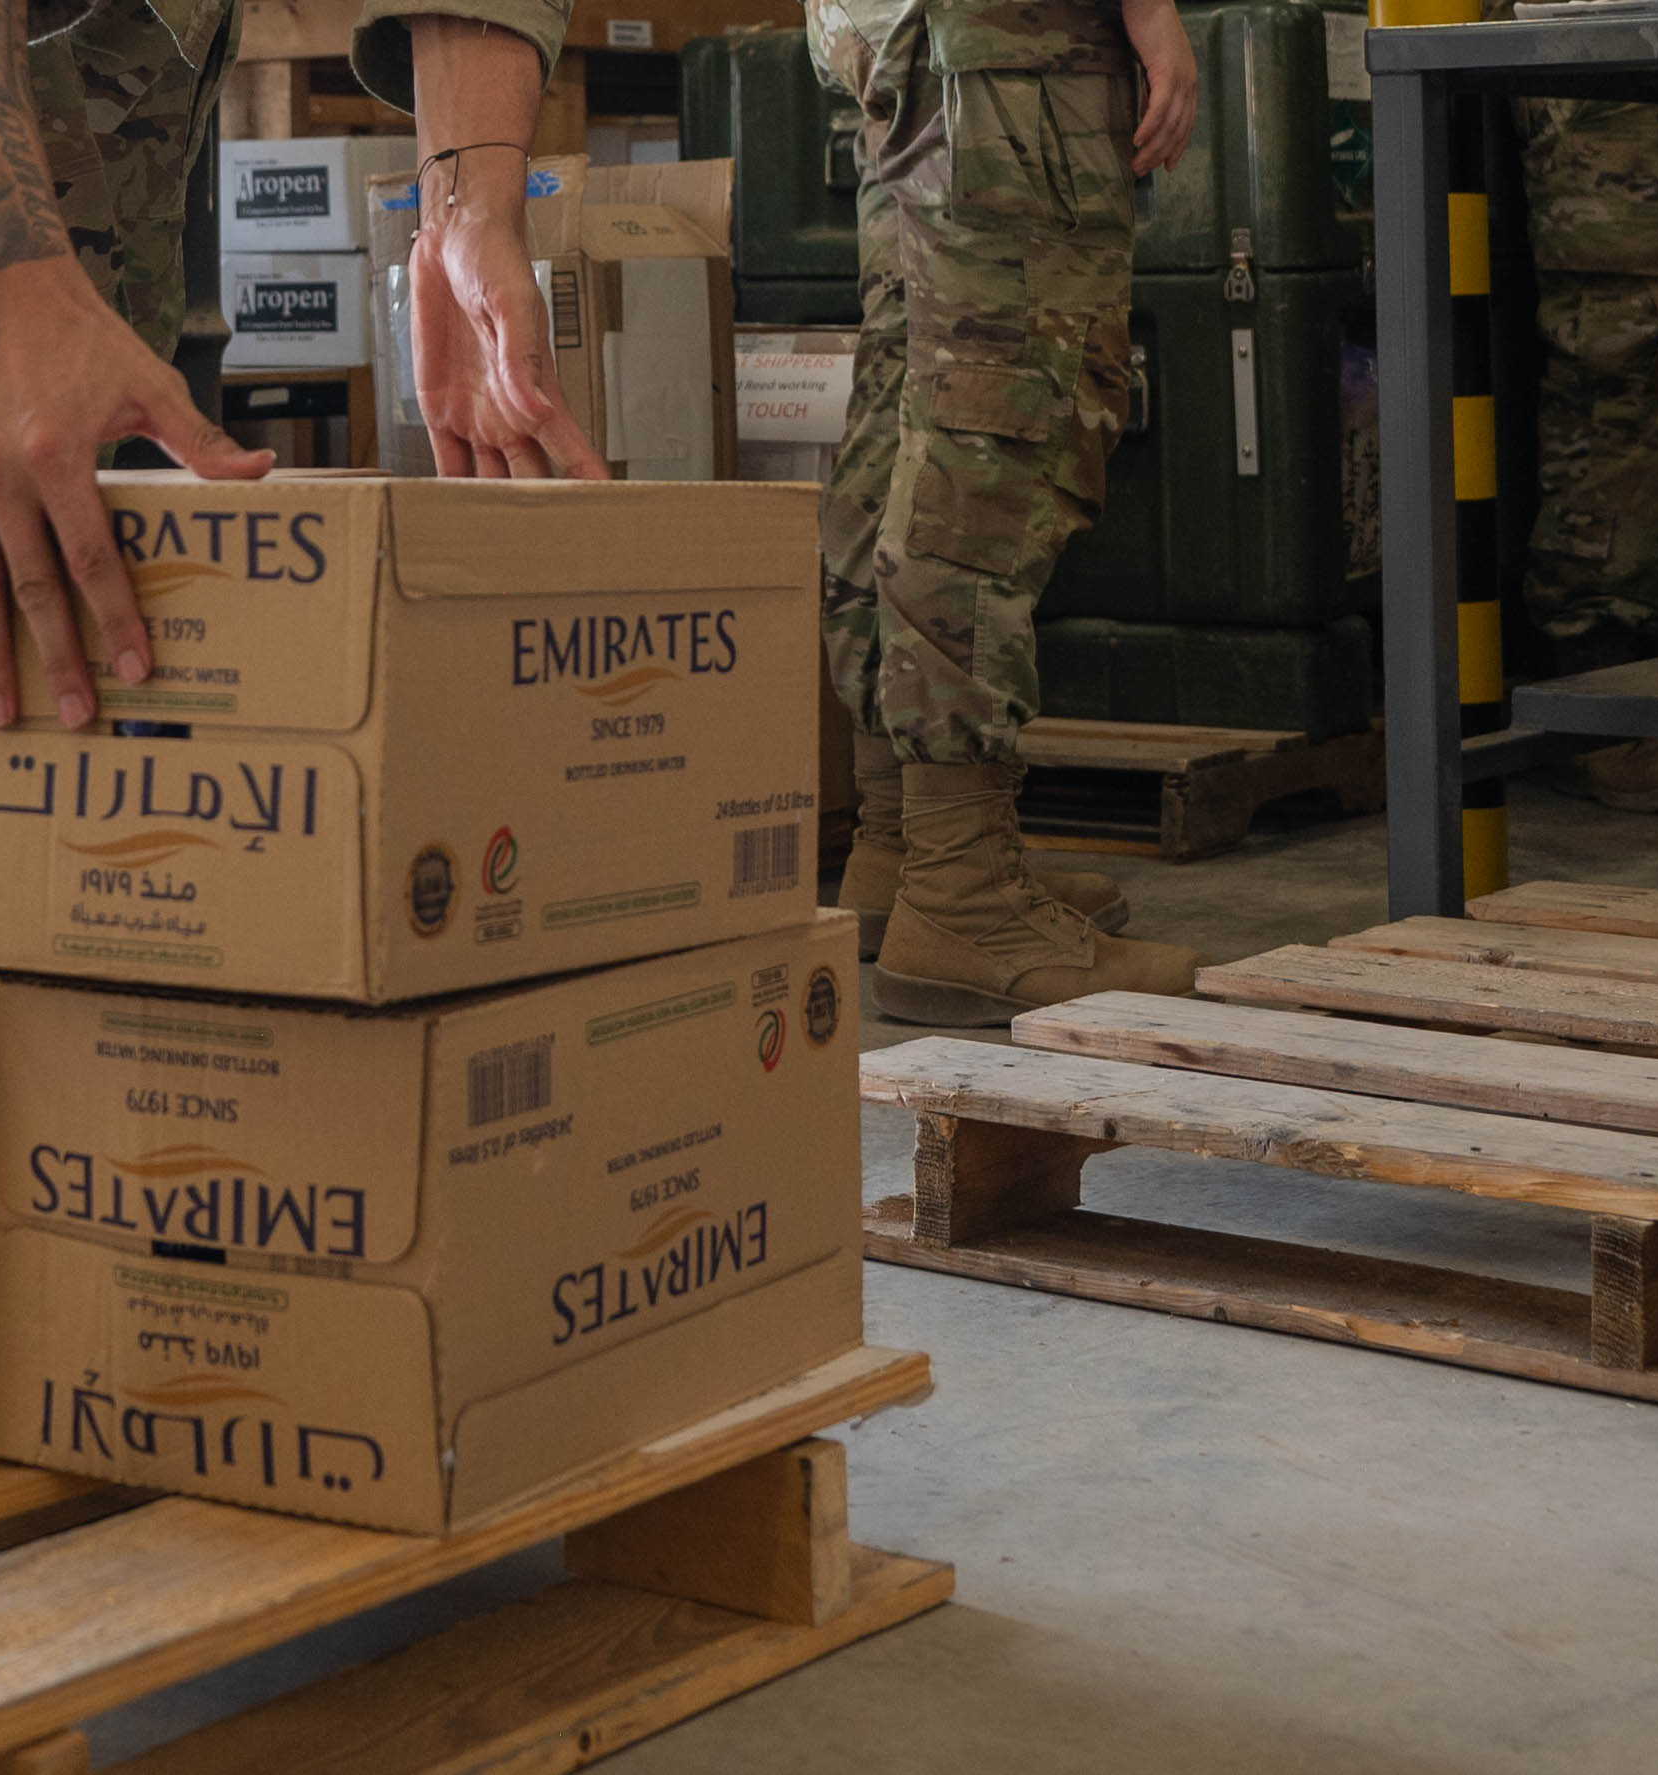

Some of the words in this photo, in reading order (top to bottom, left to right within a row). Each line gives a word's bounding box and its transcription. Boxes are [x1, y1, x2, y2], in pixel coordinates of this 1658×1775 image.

[237, 171, 322, 202] Aropen
[237, 282, 329, 317] Aropen
[754, 354, 836, 369] SHIPPERS
[778, 378, 828, 392] working
[747, 401, 809, 419] TOUCH
[111, 508, 327, 584] RATES
[162, 617, 206, 641] 1979
[512, 609, 738, 686] EMIRATES
[195, 667, 241, 685] WATER
[591, 716, 632, 741] SINCE
[635, 713, 665, 736] 1979
[565, 764, 608, 783] BOTTLED
[611, 759, 654, 778] DRINKING
[657, 755, 686, 772] WATER
[80, 866, 132, 894] ١٩٧٩
[140, 871, 197, 902] منذ
[96, 1039, 136, 1059] WATER
[140, 1045, 209, 1067] DRINKING
[213, 1054, 280, 1075] BOTTLED
[126, 1088, 168, 1115] 1979
[176, 1093, 239, 1123] SINCE
[630, 1183, 659, 1212] 1979
[662, 1168, 701, 1201] SINCE
[30, 1144, 366, 1257] EMIRATES
[552, 1201, 767, 1345] EMIRATES
[138, 1330, 196, 1365] منذ
[206, 1341, 261, 1370] ١٩٧٩
[41, 1368, 384, 1492] الإمارات
